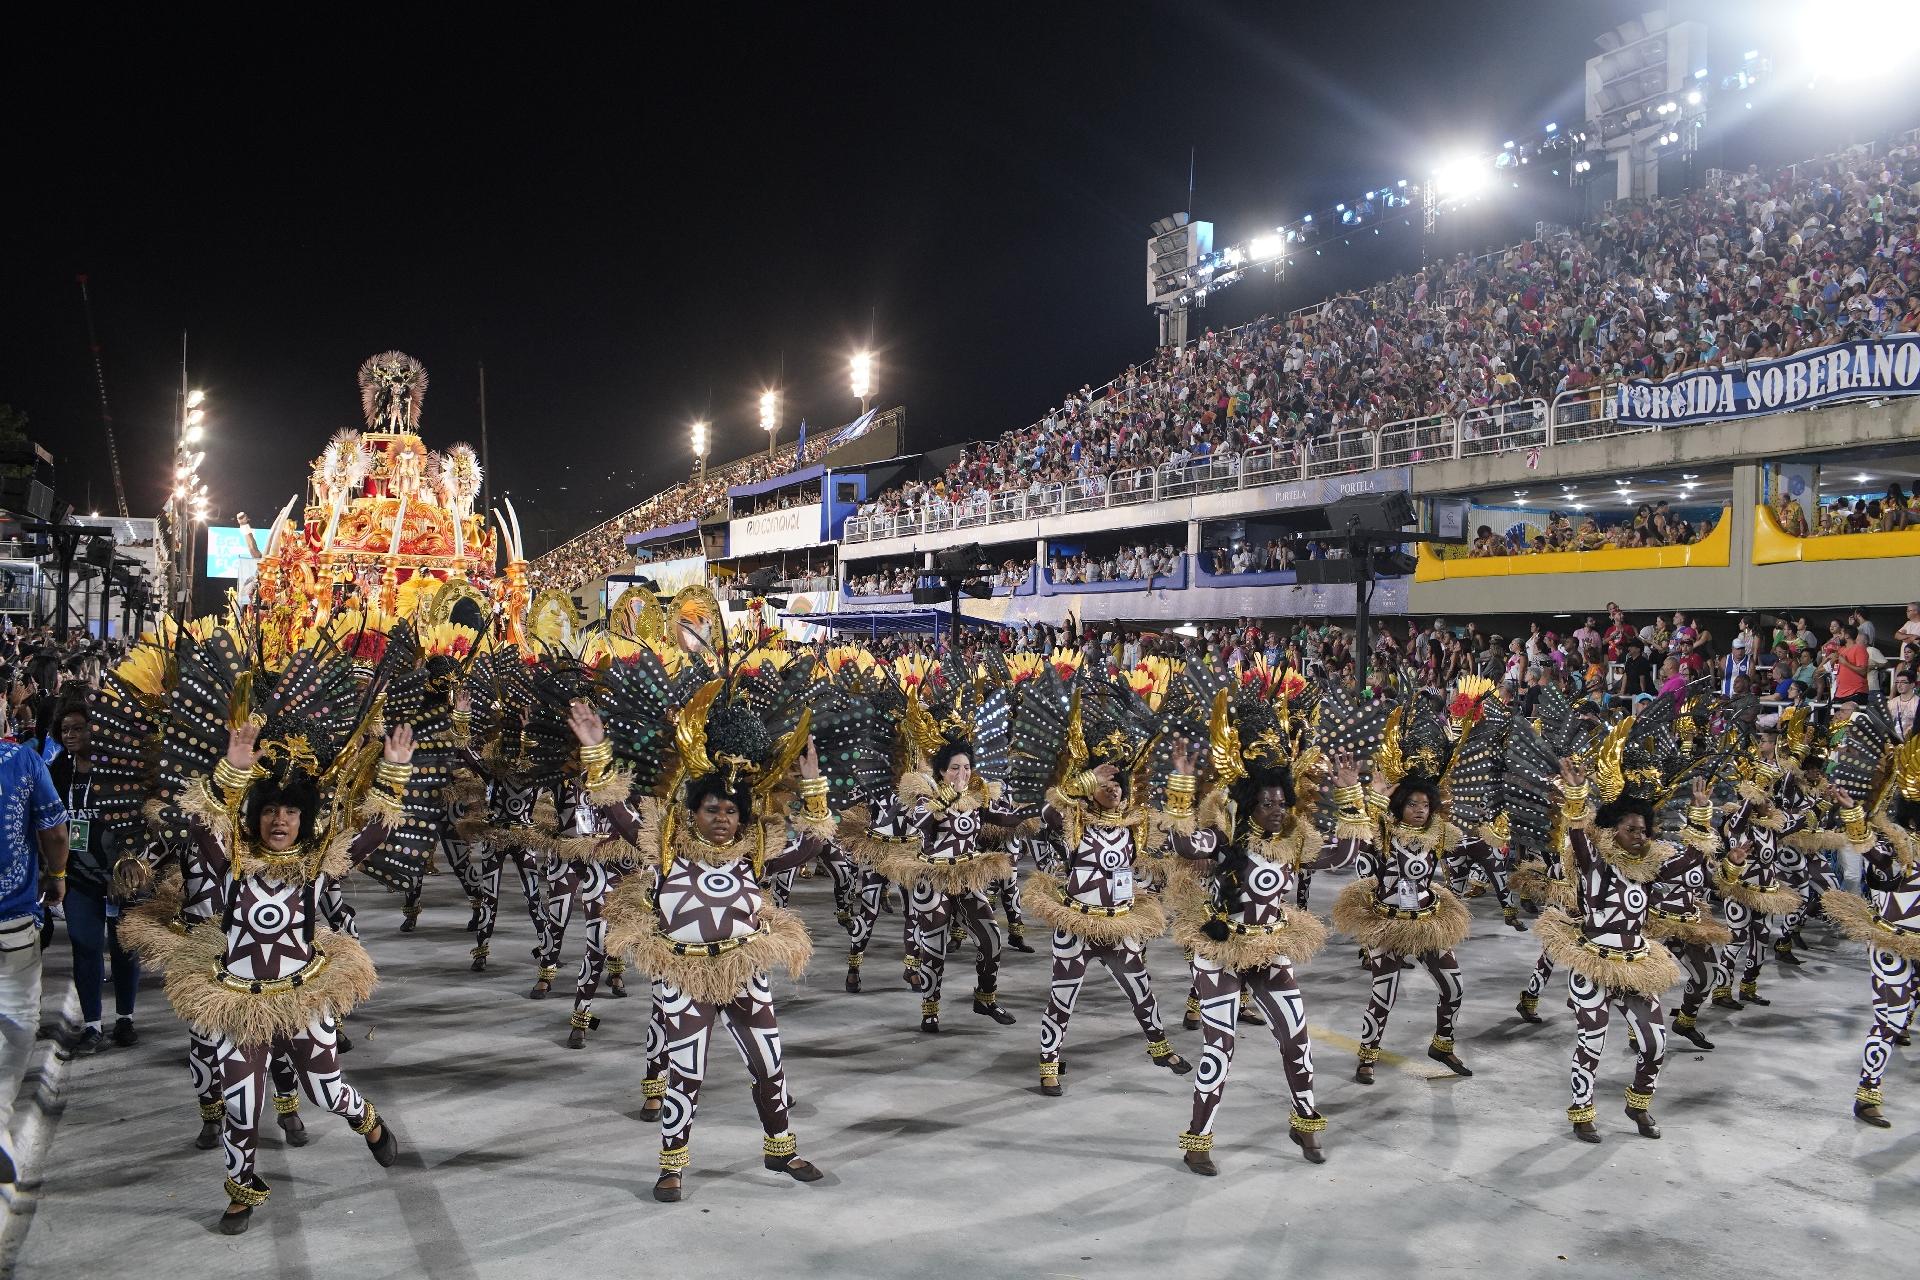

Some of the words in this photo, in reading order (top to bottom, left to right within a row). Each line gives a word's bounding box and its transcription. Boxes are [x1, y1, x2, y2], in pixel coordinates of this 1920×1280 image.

[1618, 373, 1737, 419] TORCIDA
[1746, 342, 1920, 411] SOBERANO
[1340, 480, 1375, 495] PORTELA
[1275, 488, 1307, 502] PORTELA
[67, 808, 101, 820] TAFF
